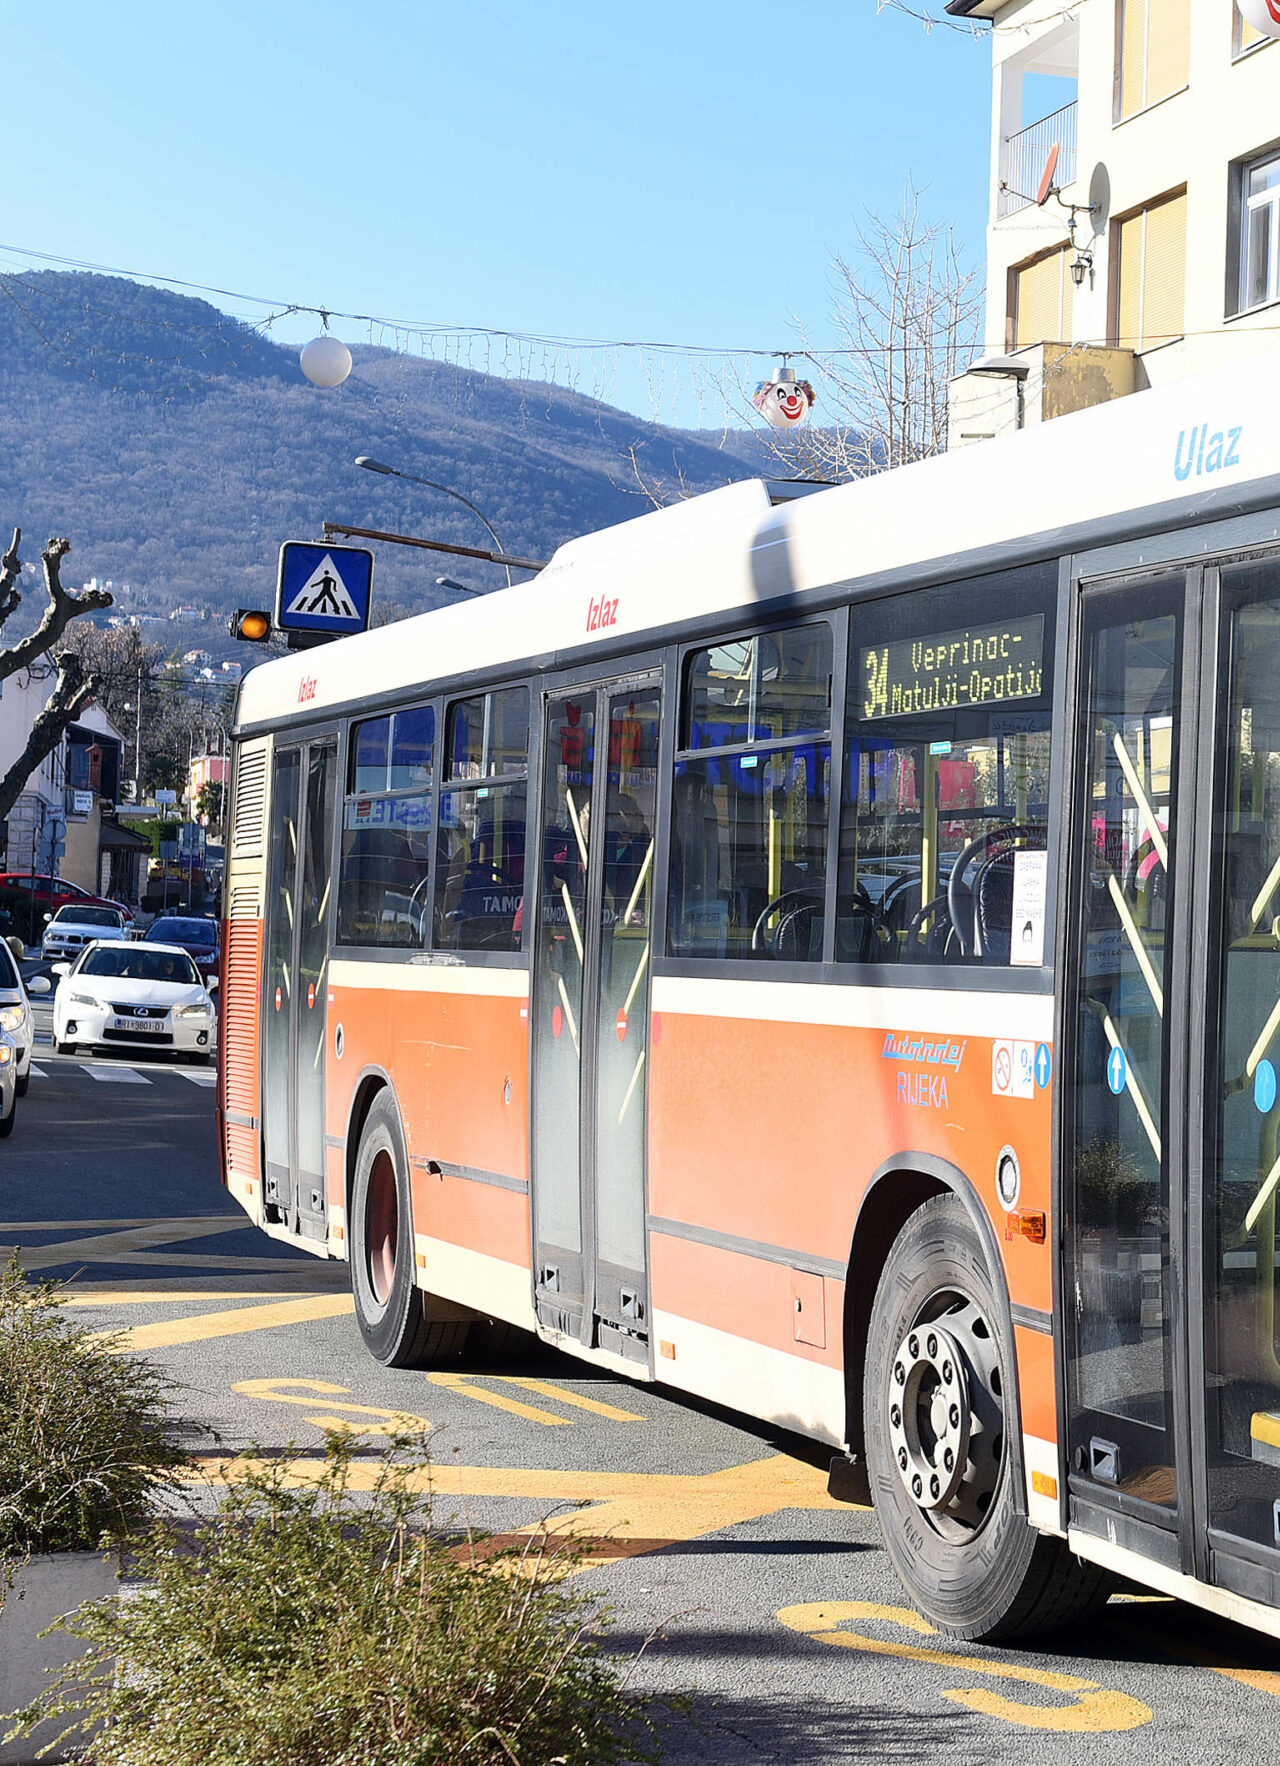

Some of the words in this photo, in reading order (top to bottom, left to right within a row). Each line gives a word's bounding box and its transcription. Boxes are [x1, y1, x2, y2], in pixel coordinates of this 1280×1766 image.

[1174, 423, 1242, 481] Ulaz
[586, 593, 620, 632] Izlaz
[911, 632, 1022, 673] Veprinac-
[297, 675, 317, 703] Izlaz
[864, 648, 889, 718] 34
[896, 1071, 950, 1110] RIJEKA
